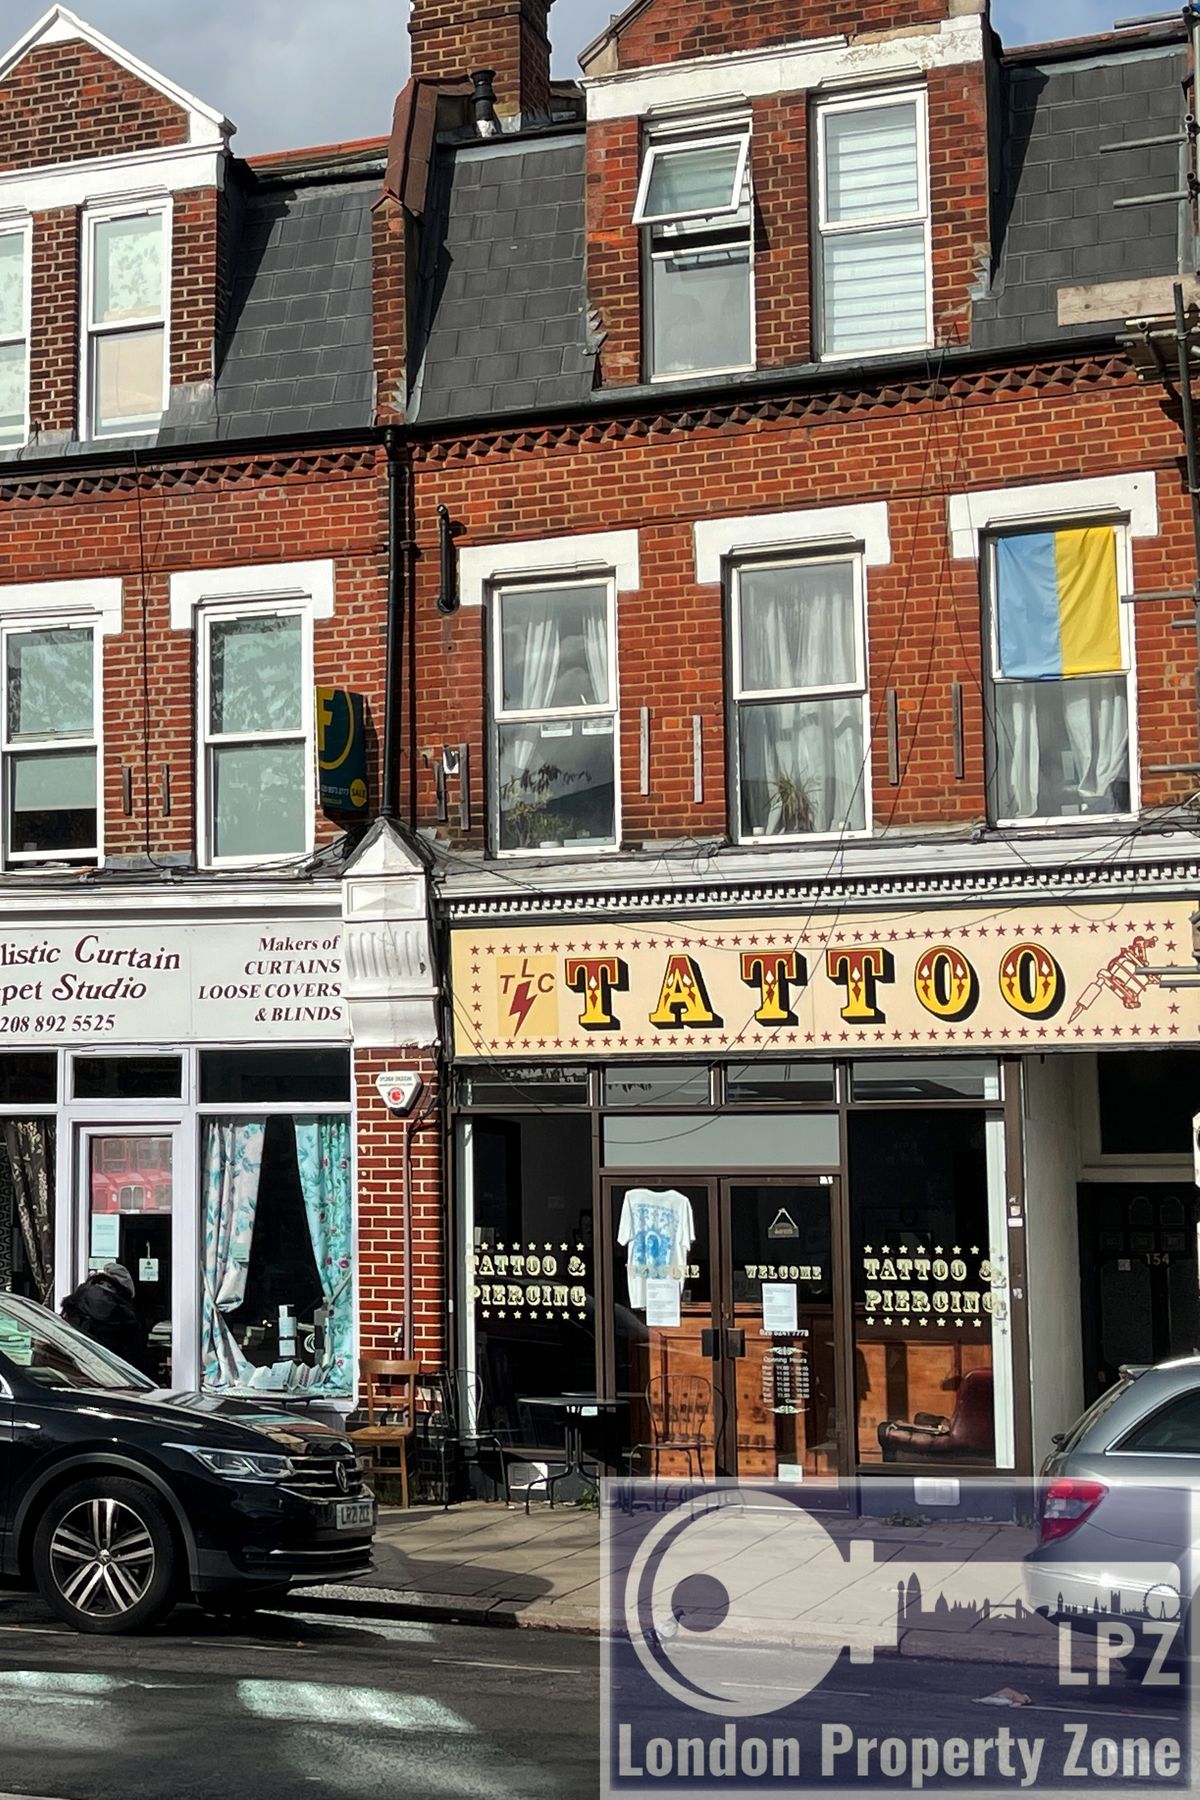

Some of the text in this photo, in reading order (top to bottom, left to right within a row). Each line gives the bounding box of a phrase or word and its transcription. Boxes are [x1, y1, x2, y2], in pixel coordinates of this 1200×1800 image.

[74, 935, 181, 970] Curtain
[259, 935, 341, 951] Makers of
[244, 959, 342, 975] CURTAINS
[51, 973, 147, 1001] Studio
[198, 982, 342, 1000] LOOSE COVERS
[565, 941, 1067, 1031] TATTOO
[34, 1015, 66, 1032] 892
[71, 1013, 116, 1032] 5525
[254, 1006, 343, 1022] & BLINDS
[466, 1255, 586, 1276] TATTOO &
[1145, 1253, 1170, 1265] 154
[744, 1265, 822, 1280] WELCOME
[863, 1258, 967, 1281] TATTOO
[468, 1285, 586, 1307] PIERCING
